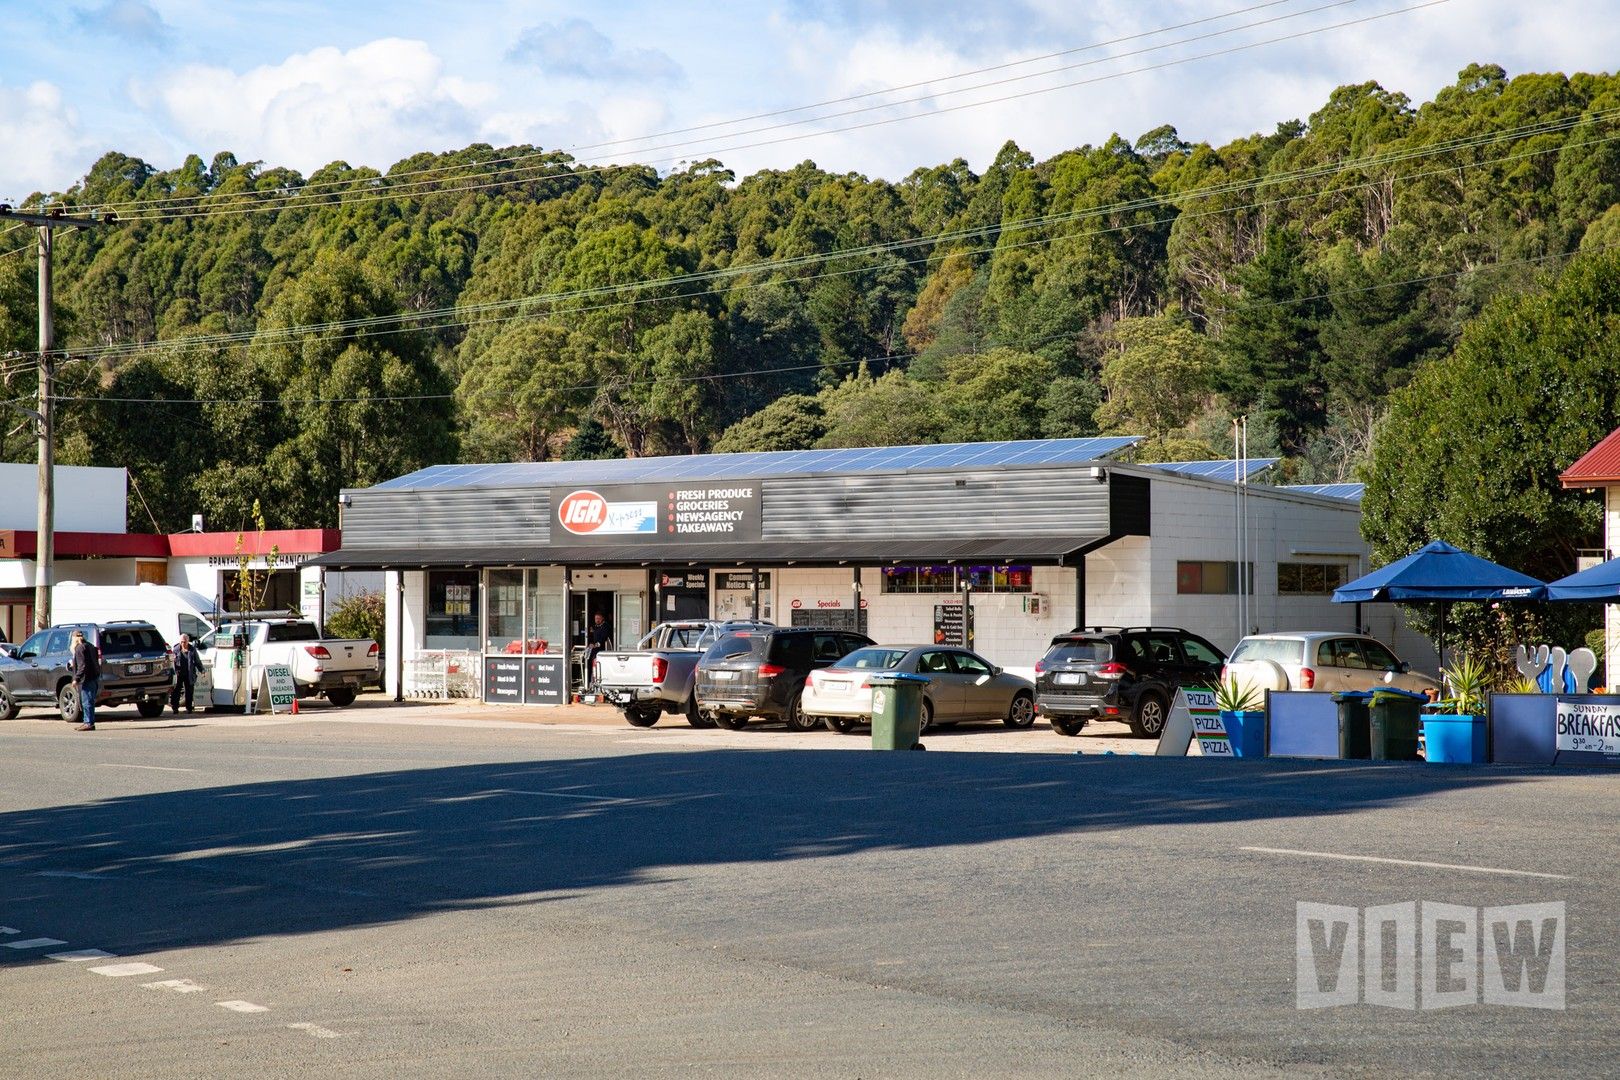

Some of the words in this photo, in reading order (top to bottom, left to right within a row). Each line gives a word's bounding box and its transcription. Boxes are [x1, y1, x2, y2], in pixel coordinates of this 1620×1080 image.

[676, 490, 705, 500] FRESH
[708, 488, 753, 499] PRODUCE
[676, 500, 729, 511] GROCERIES
[564, 499, 602, 524] IGA
[676, 511, 743, 522] NEWSAGENCY
[676, 522, 734, 533] TAKEAWAYS
[726, 581, 746, 589] Notice
[817, 600, 841, 608] Specials
[268, 668, 290, 677] DIESEL
[273, 695, 294, 704] OPEN
[1187, 693, 1215, 705] PIZZA
[1573, 704, 1608, 713] SUNDAY
[1194, 717, 1223, 730] PIZZA
[1202, 741, 1231, 754] PIZZA
